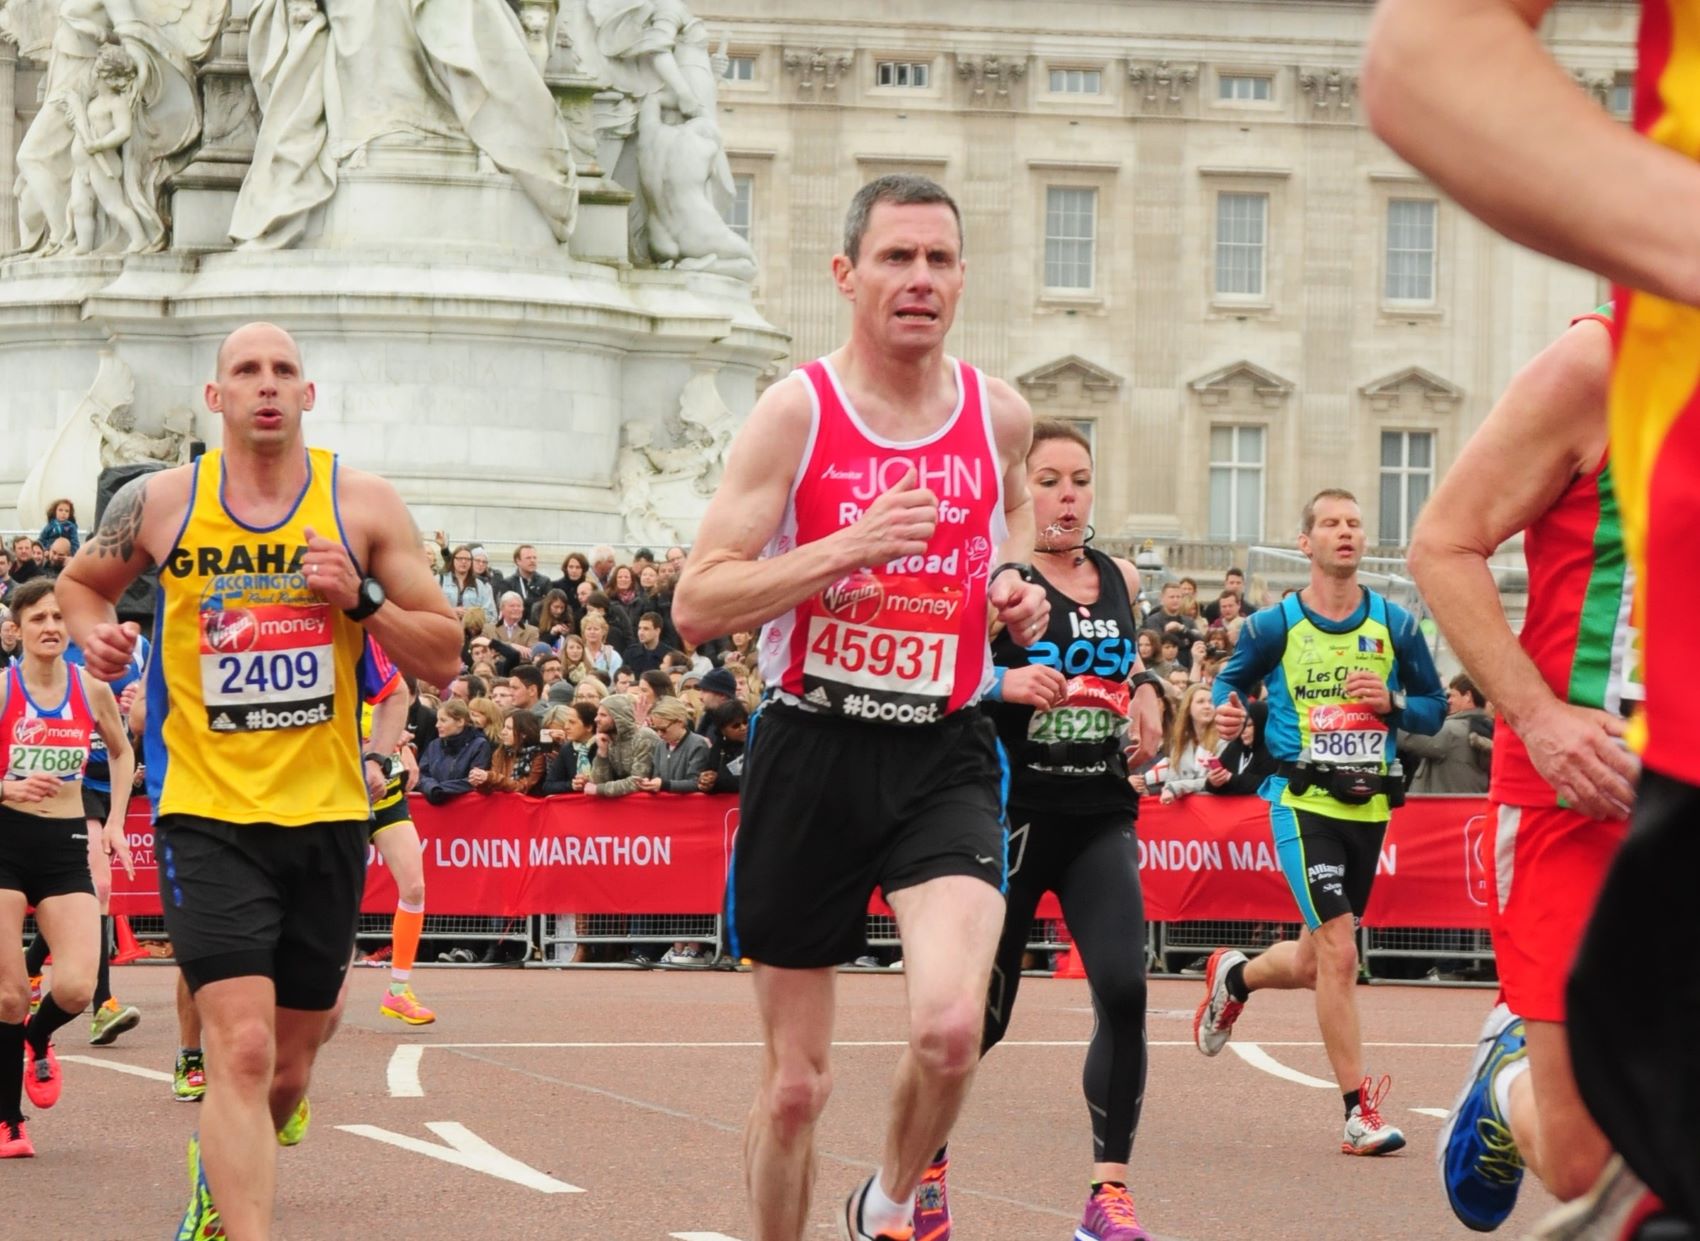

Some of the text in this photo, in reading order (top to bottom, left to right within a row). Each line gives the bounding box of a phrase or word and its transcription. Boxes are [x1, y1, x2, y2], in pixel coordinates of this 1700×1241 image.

[852, 455, 981, 500] JOHN
[938, 501, 970, 525] for
[170, 544, 309, 578] GRAHA
[886, 548, 959, 576] Road
[214, 574, 308, 591] ACCRINGTO
[824, 577, 958, 621] Virgin money
[260, 617, 326, 635] money
[811, 623, 945, 683] 45931
[219, 651, 319, 694] 2409
[1306, 668, 1331, 684] Les
[246, 702, 328, 730] #boost
[843, 694, 939, 724] #boost
[47, 728, 84, 741] money
[1032, 708, 1118, 742] 2629
[1314, 732, 1383, 756] 58612
[13, 747, 85, 771] 27688
[529, 836, 671, 867] MARATHON
[1137, 839, 1223, 872] ONDON
